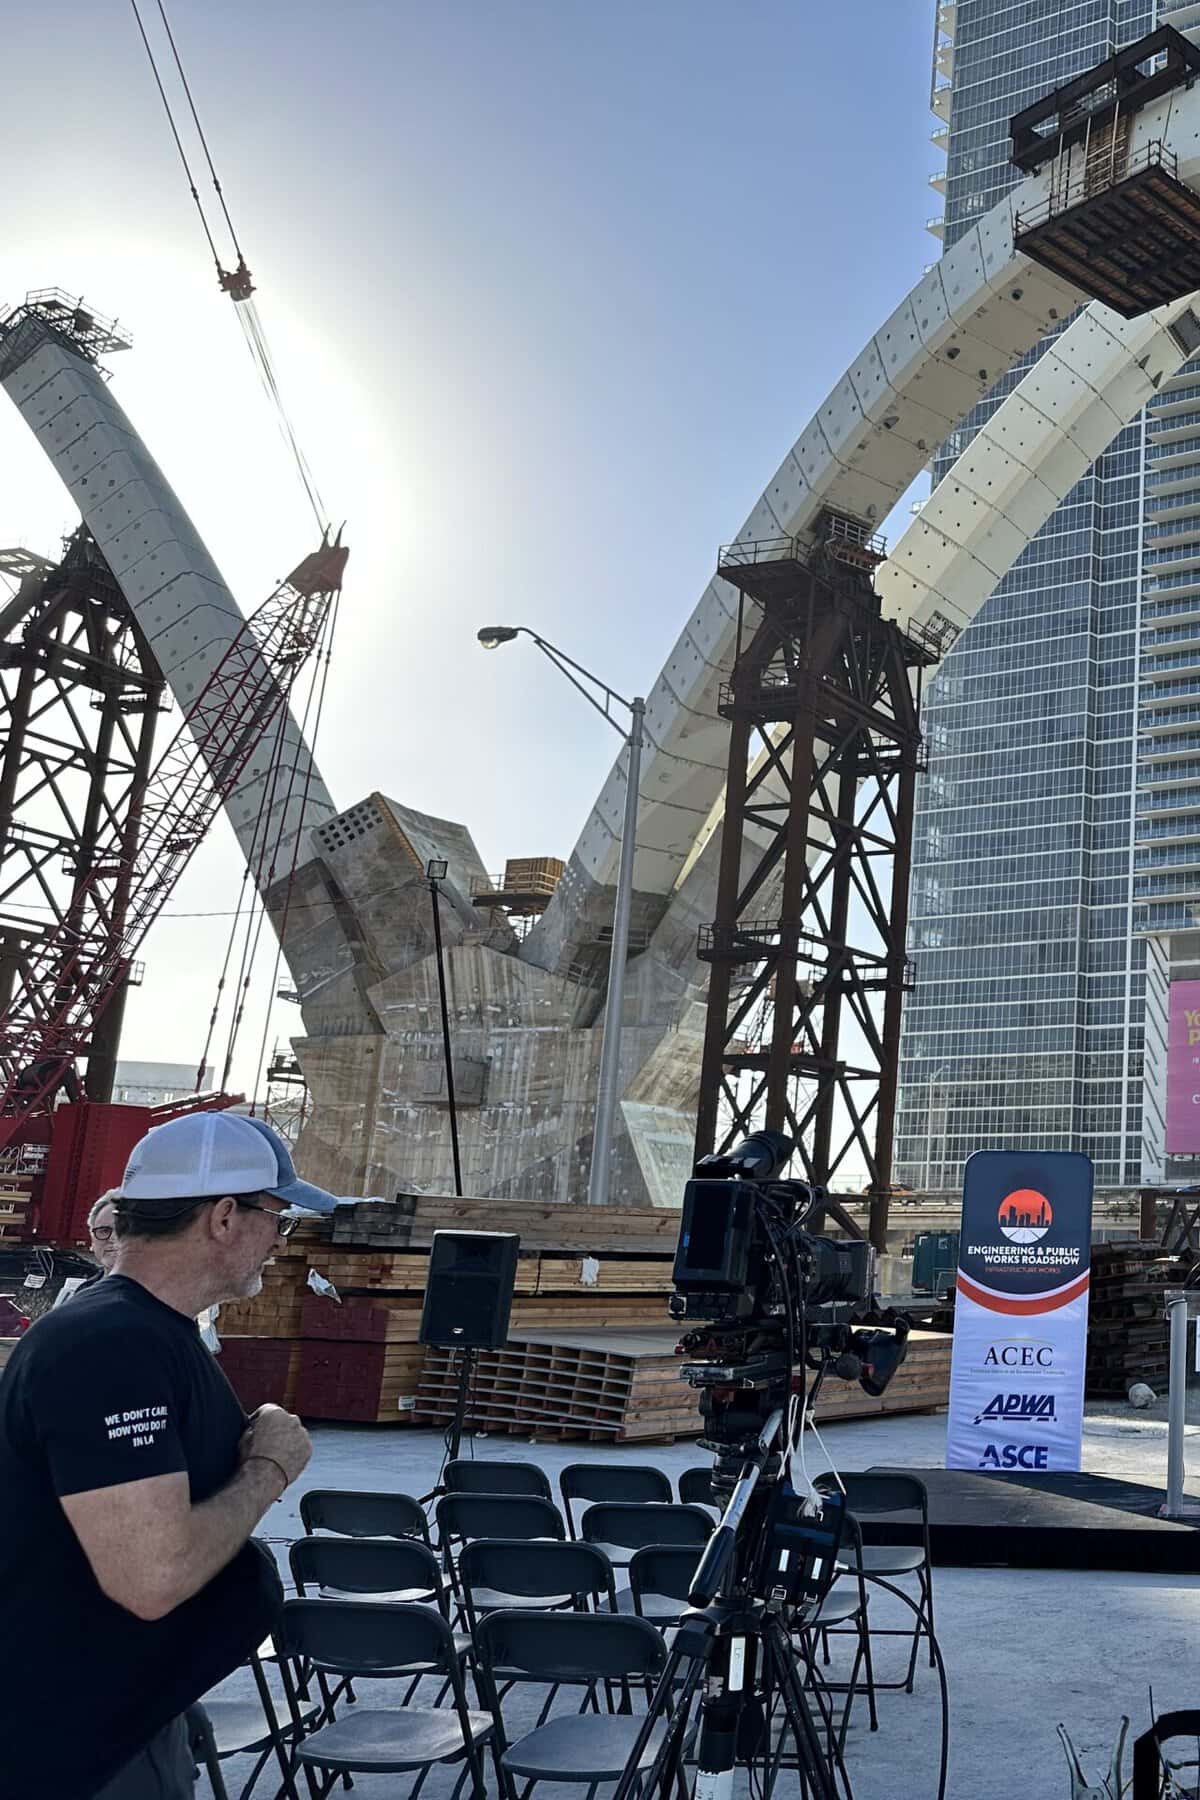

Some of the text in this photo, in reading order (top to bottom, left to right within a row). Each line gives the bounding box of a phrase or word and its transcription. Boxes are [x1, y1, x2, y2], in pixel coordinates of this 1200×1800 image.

[967, 1246, 1080, 1256] ENGINEERING & PUBLIC
[984, 1255, 1080, 1265] WORKS ROADSHOW
[984, 1346, 1053, 1367] ACEC
[981, 1394, 1055, 1417] APWA
[104, 1413, 121, 1426] WE
[122, 1407, 150, 1422] DON'T
[108, 1425, 132, 1440] HOW
[131, 1421, 149, 1433] YOU
[150, 1420, 160, 1431] DO
[132, 1434, 154, 1447] IN LA
[978, 1444, 1049, 1469] ASCE
